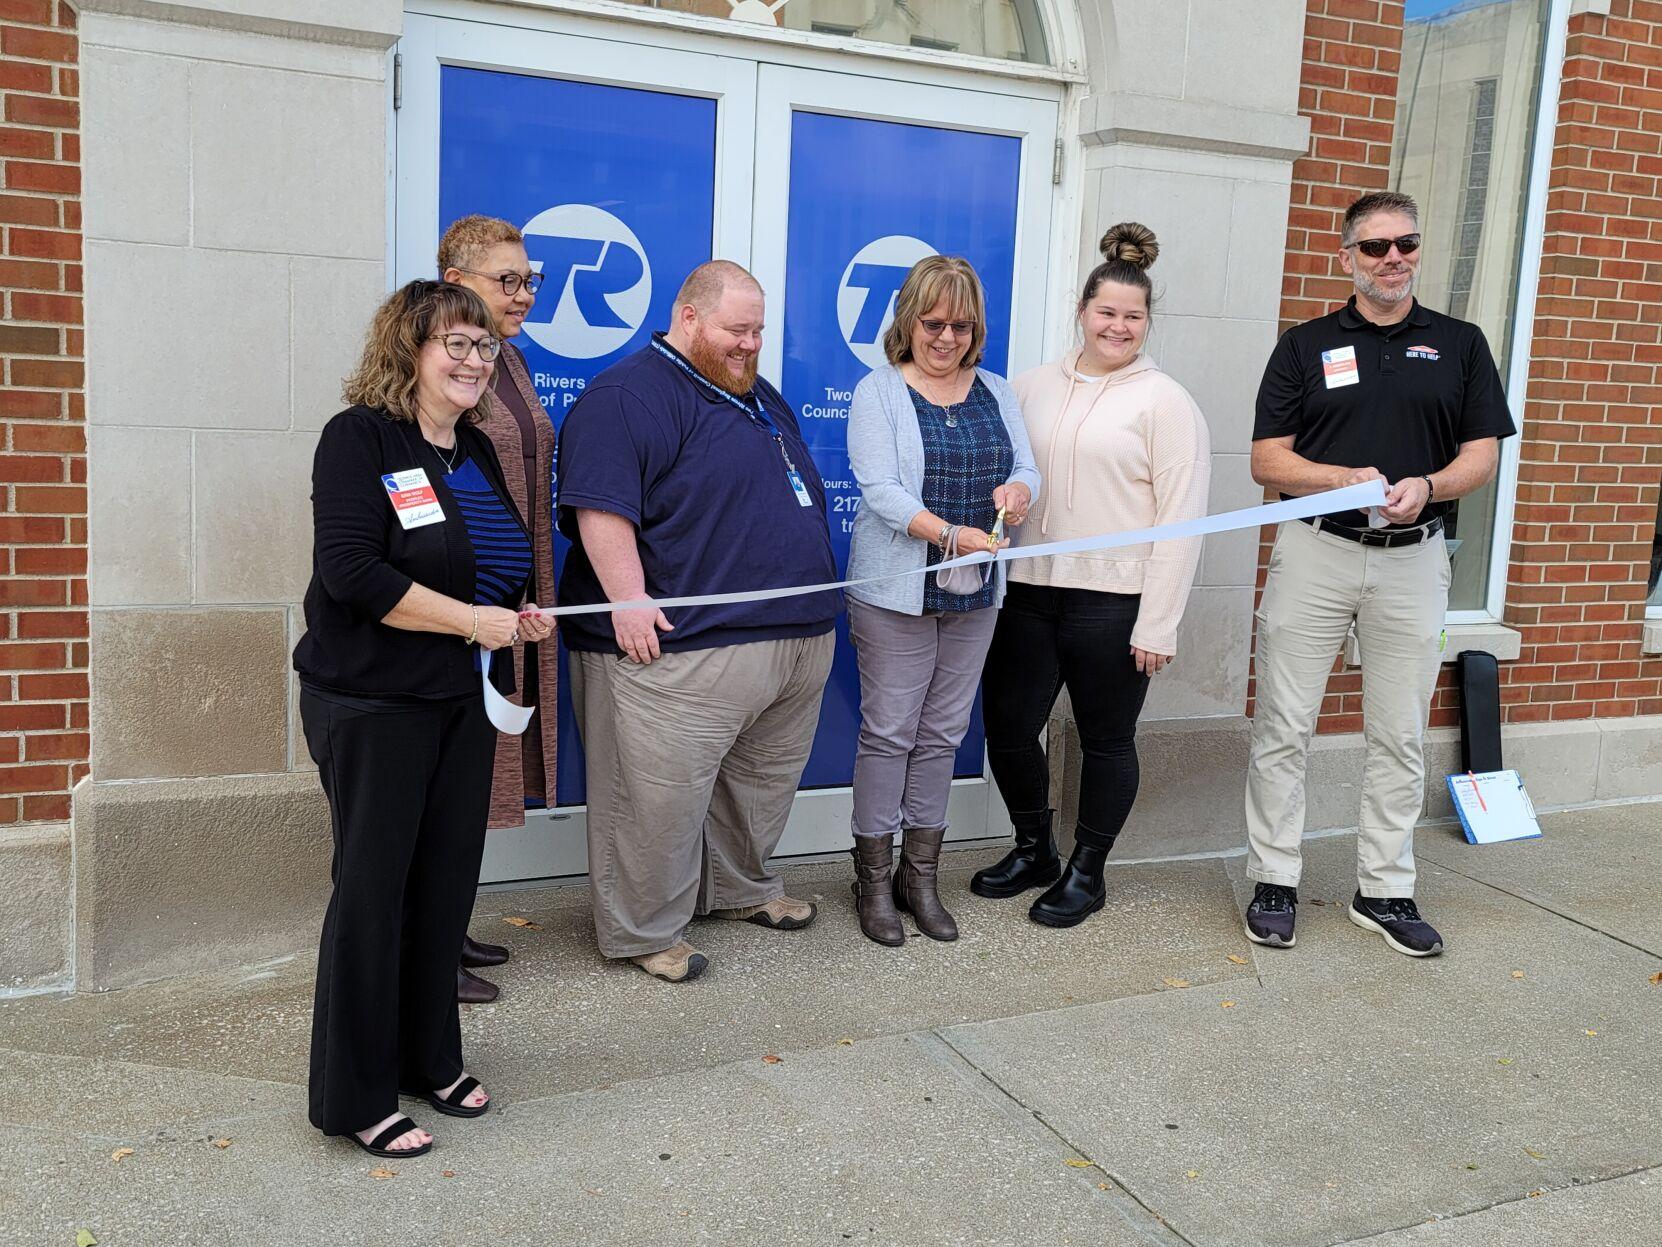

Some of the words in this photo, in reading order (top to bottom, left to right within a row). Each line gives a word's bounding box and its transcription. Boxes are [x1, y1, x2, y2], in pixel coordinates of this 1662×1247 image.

[534, 372, 586, 389] Rivers
[539, 392, 556, 407] of
[824, 387, 852, 402] Two
[821, 478, 852, 489] ours:
[833, 495, 861, 512] 217
